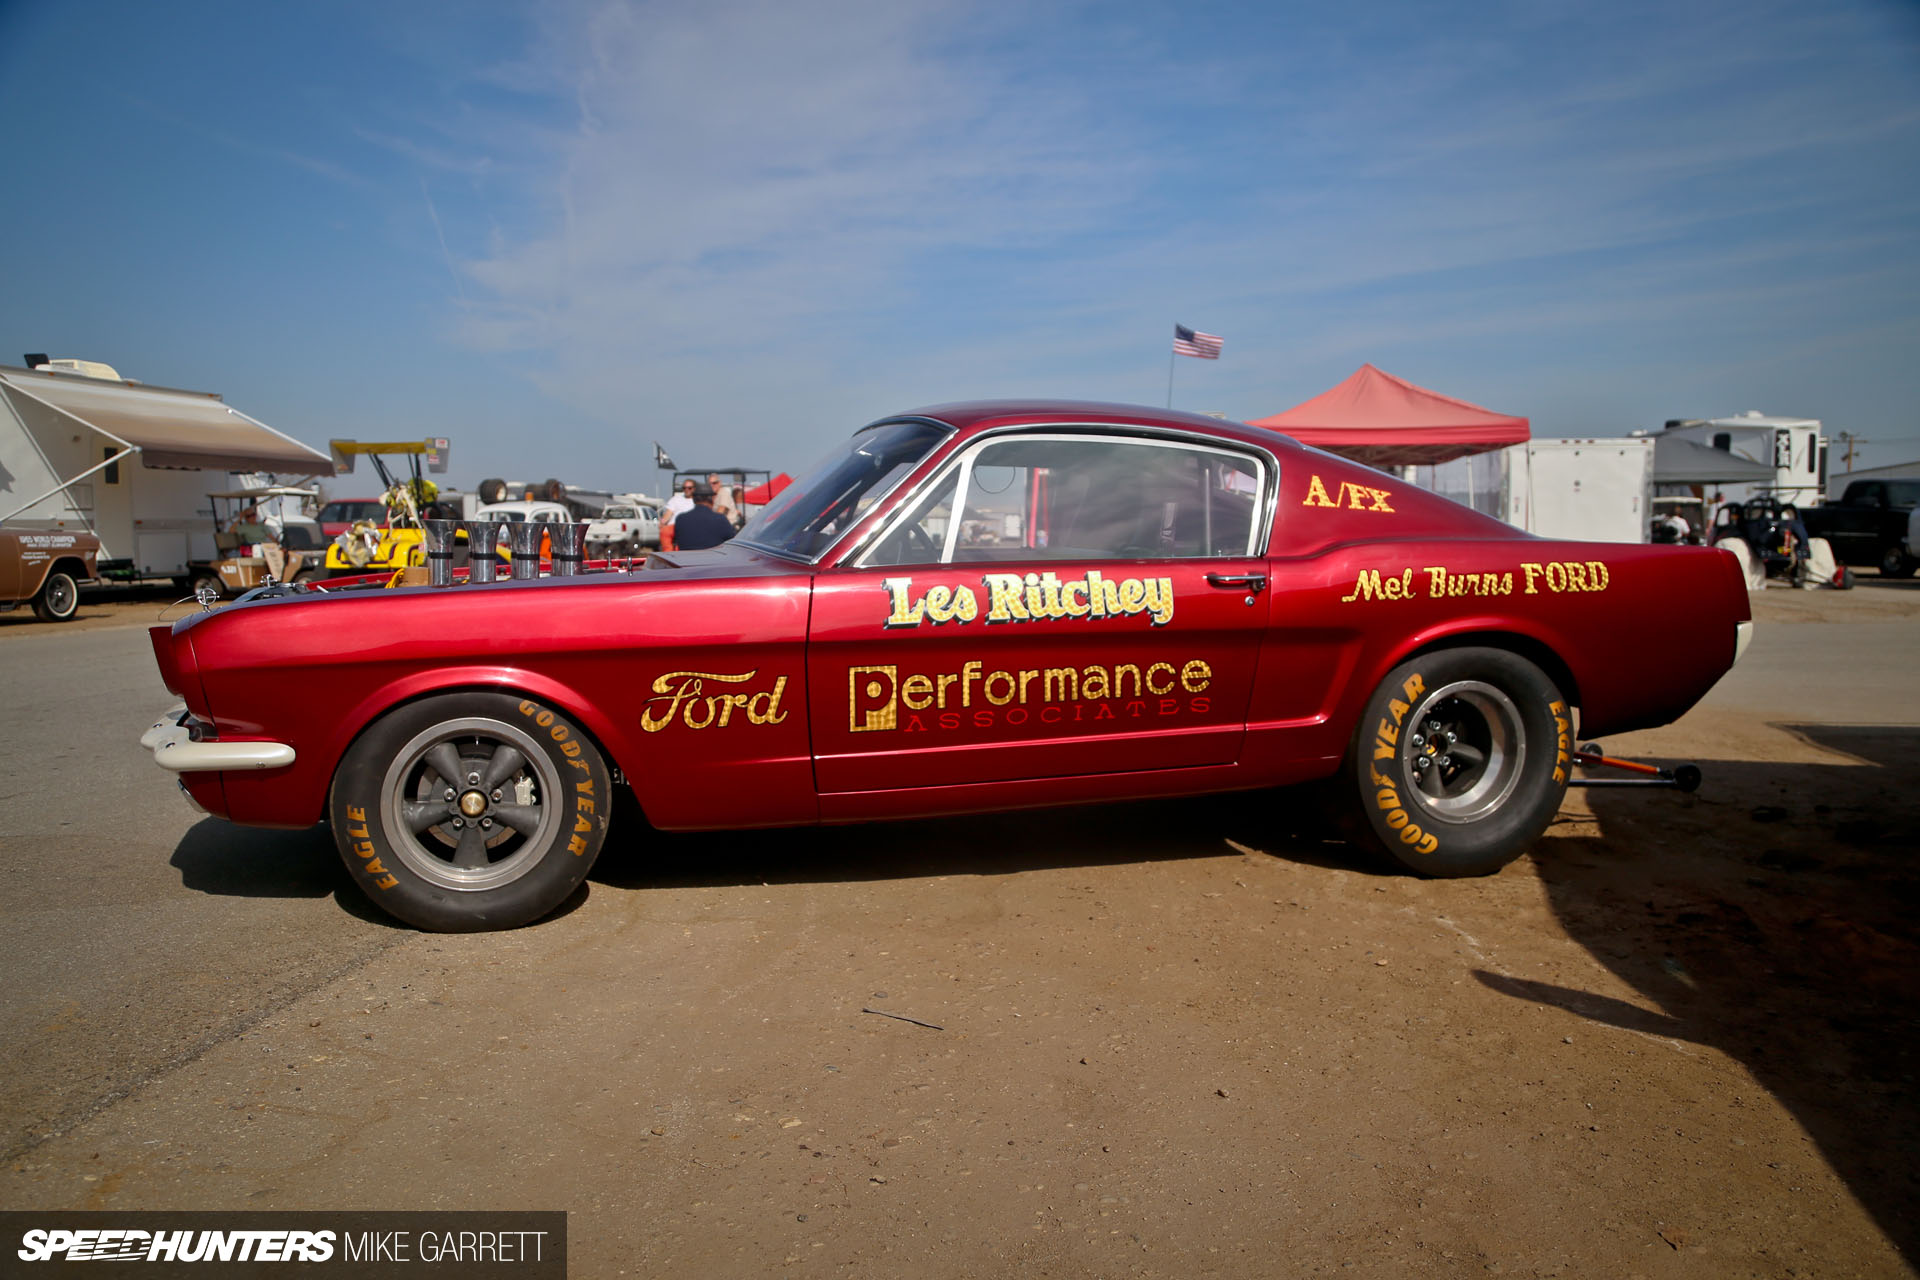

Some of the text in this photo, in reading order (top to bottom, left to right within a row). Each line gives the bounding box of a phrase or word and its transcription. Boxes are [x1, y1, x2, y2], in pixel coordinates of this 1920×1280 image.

[1303, 475, 1395, 513] A/FX
[881, 570, 1174, 629] Les Ritchey
[1341, 561, 1609, 602] Mel Burns FORD
[638, 669, 788, 732] Ford
[903, 697, 1211, 732] ASSOCIATES
[1548, 700, 1571, 786] EAGLE
[346, 804, 400, 891] EAGLE
